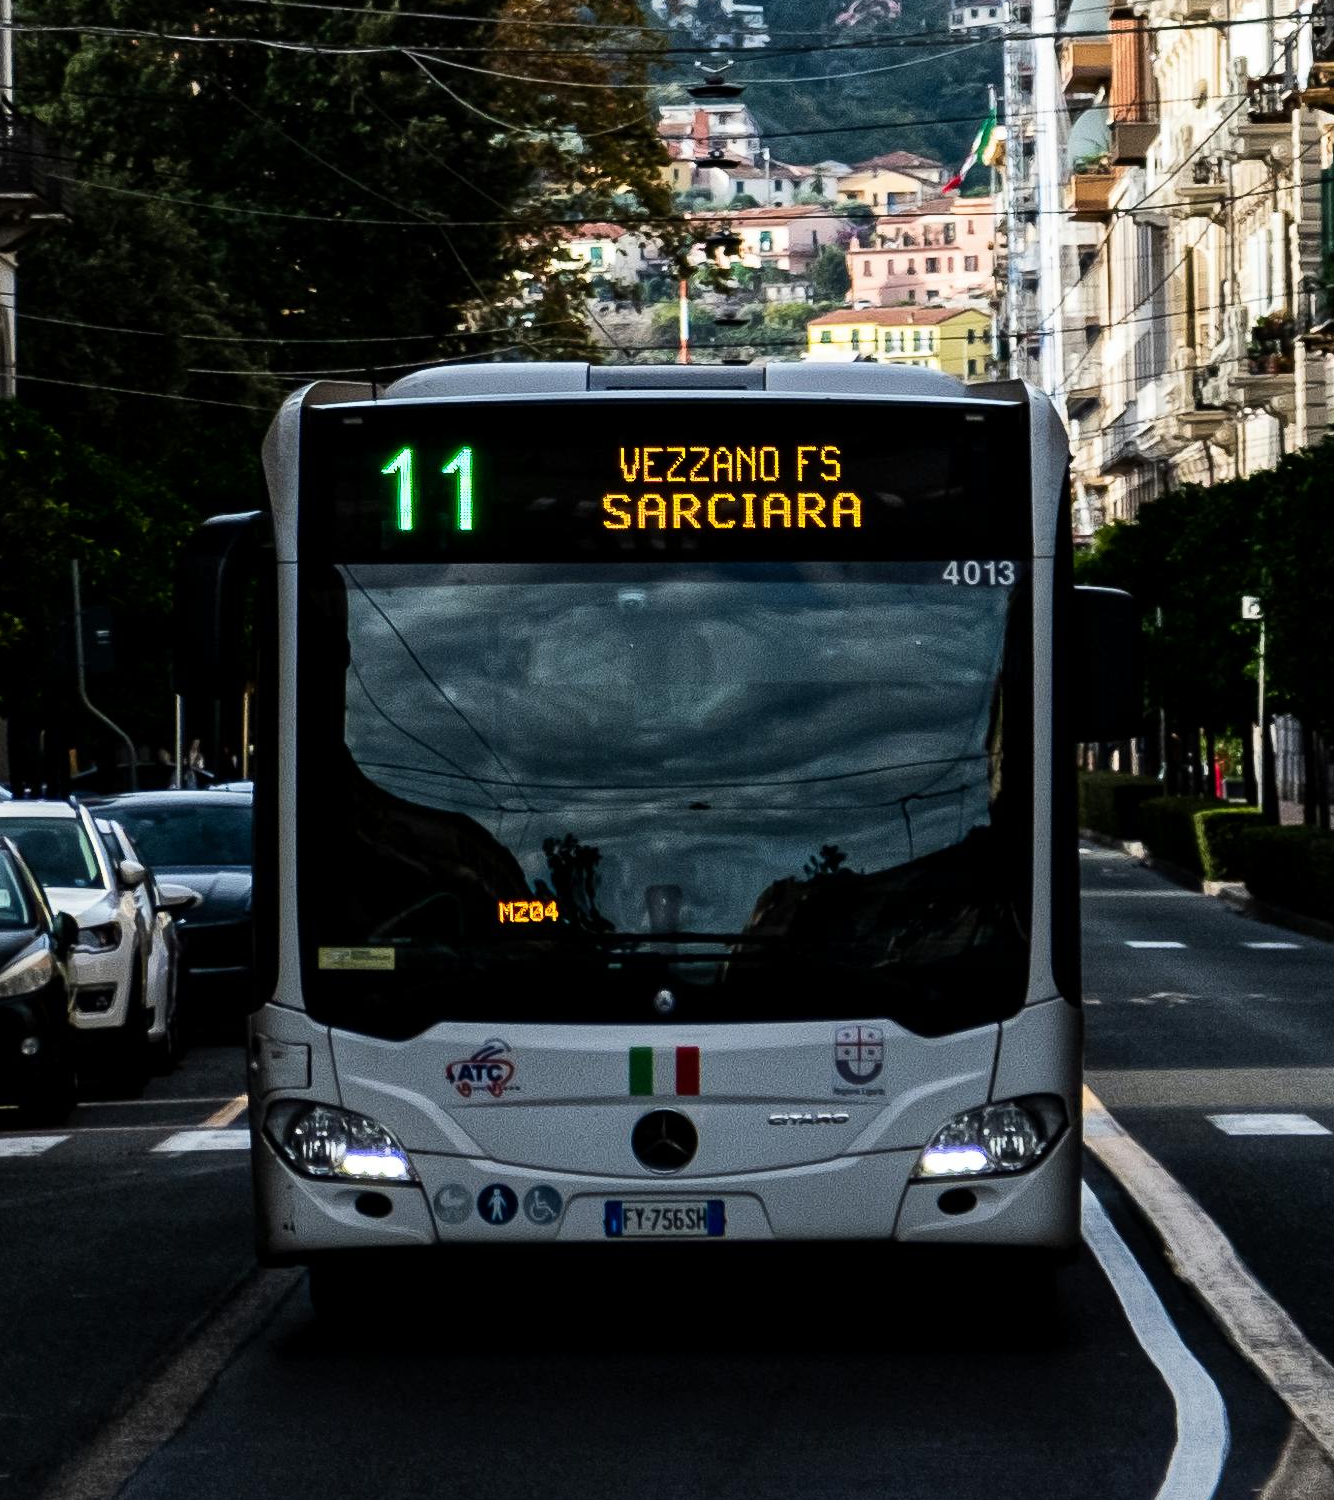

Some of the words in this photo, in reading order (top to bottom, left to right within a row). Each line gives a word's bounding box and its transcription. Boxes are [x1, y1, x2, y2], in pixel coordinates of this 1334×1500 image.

[620, 446, 780, 482] VEZZANO
[797, 446, 841, 482] FS
[380, 446, 473, 531] 11
[602, 492, 862, 529] SARCIARA
[942, 560, 1015, 585] 4013
[457, 1064, 504, 1082] ATC
